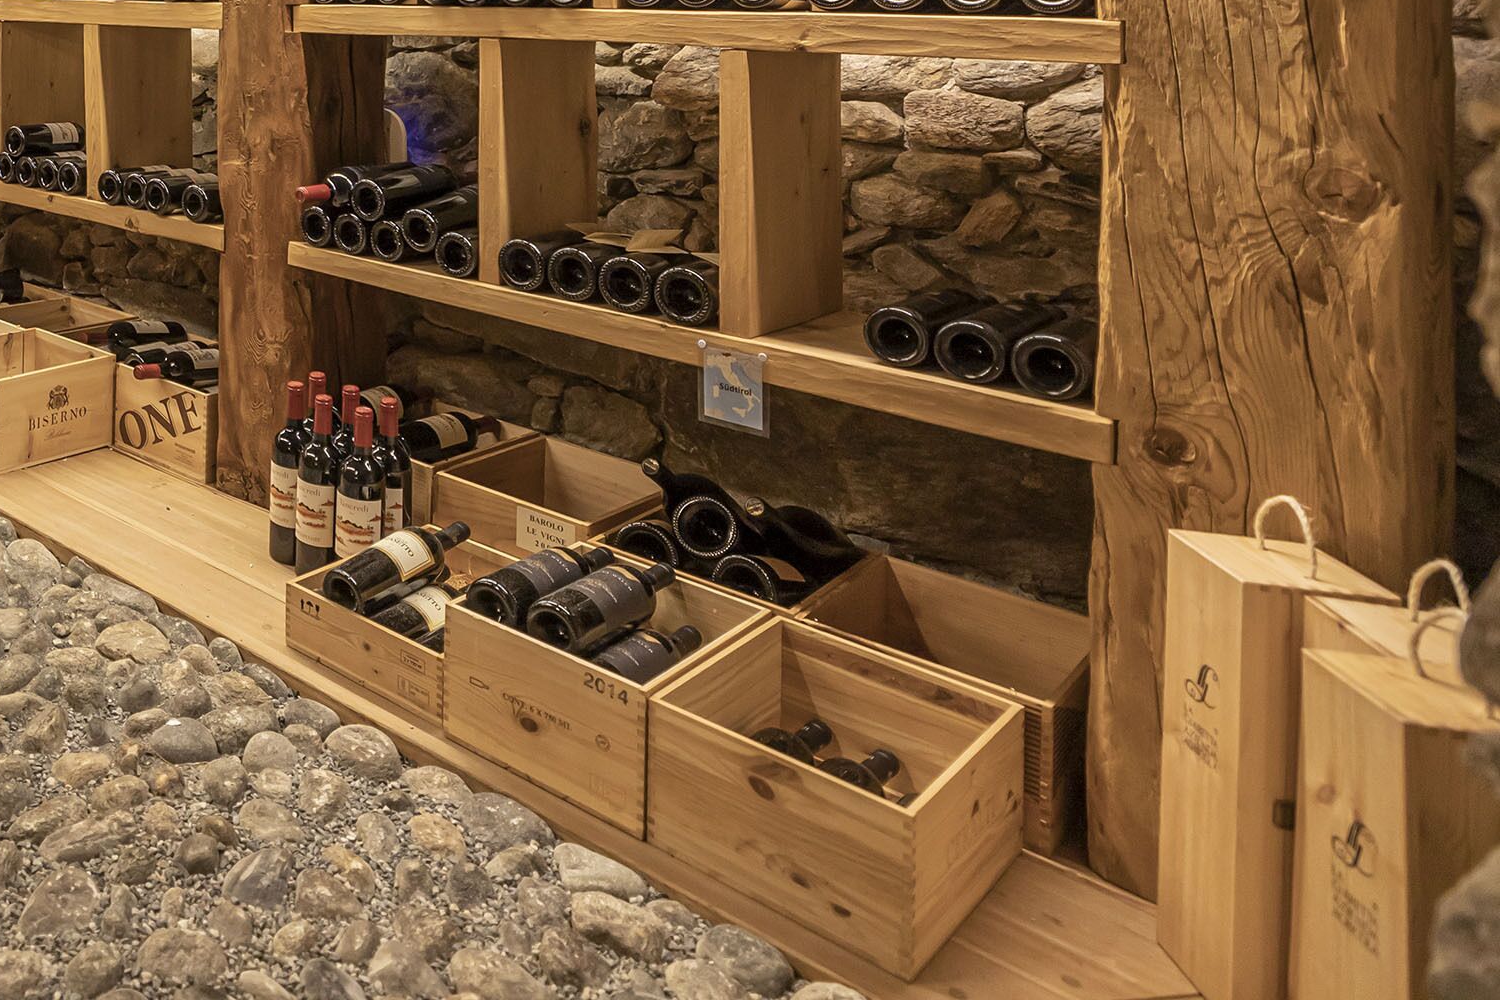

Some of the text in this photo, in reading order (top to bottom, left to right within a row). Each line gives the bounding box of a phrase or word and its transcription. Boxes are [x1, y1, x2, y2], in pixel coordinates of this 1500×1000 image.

[719, 382, 753, 397] Südtirol
[28, 406, 88, 432] BISERNO
[119, 390, 202, 450] ONE
[526, 526, 537, 536] LE
[529, 514, 564, 533] BAROLO
[583, 671, 629, 706] 2014
